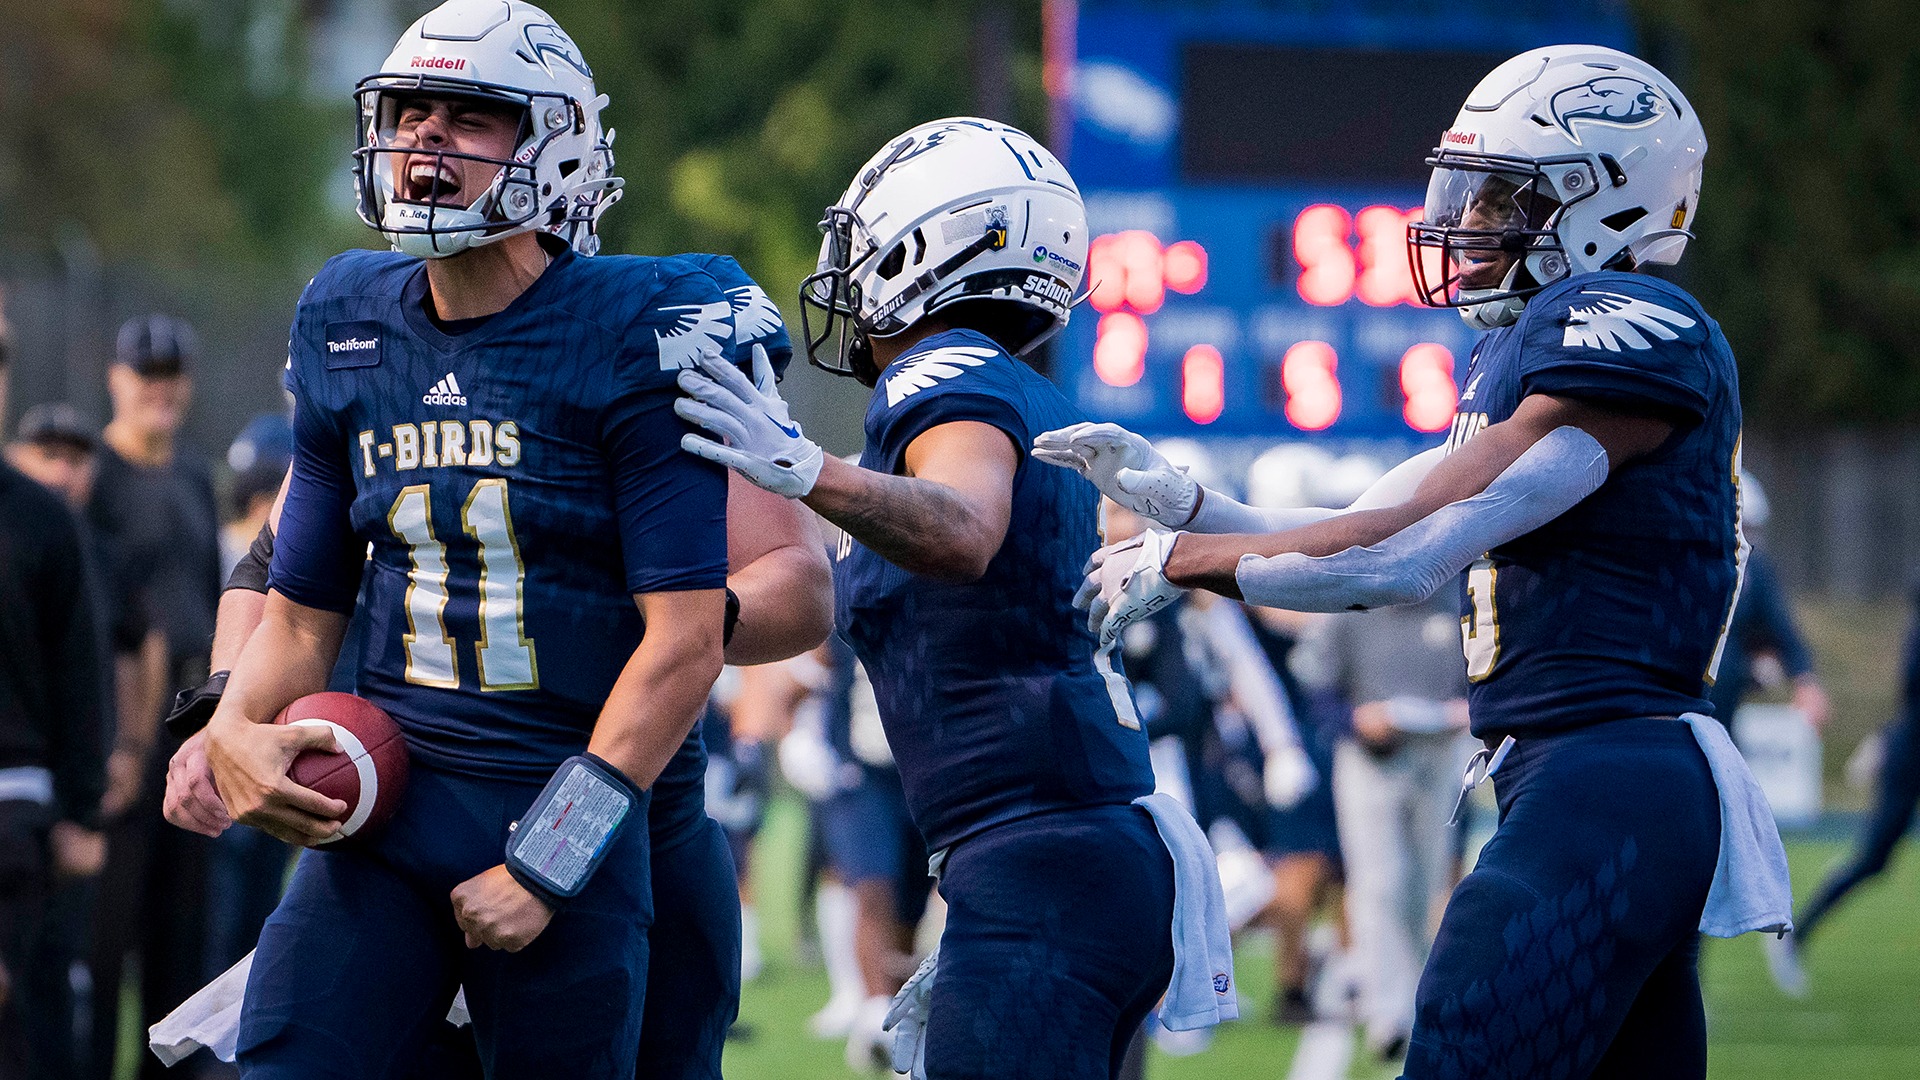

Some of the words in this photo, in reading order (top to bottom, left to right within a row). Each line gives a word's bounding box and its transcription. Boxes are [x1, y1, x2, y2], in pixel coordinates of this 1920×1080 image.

[410, 56, 466, 70] Riddell
[1048, 251, 1082, 272] OXYGEN
[872, 293, 906, 325] schutt
[422, 392, 468, 406] adidas
[359, 420, 521, 478] T-BIRDS
[386, 477, 540, 692] 11
